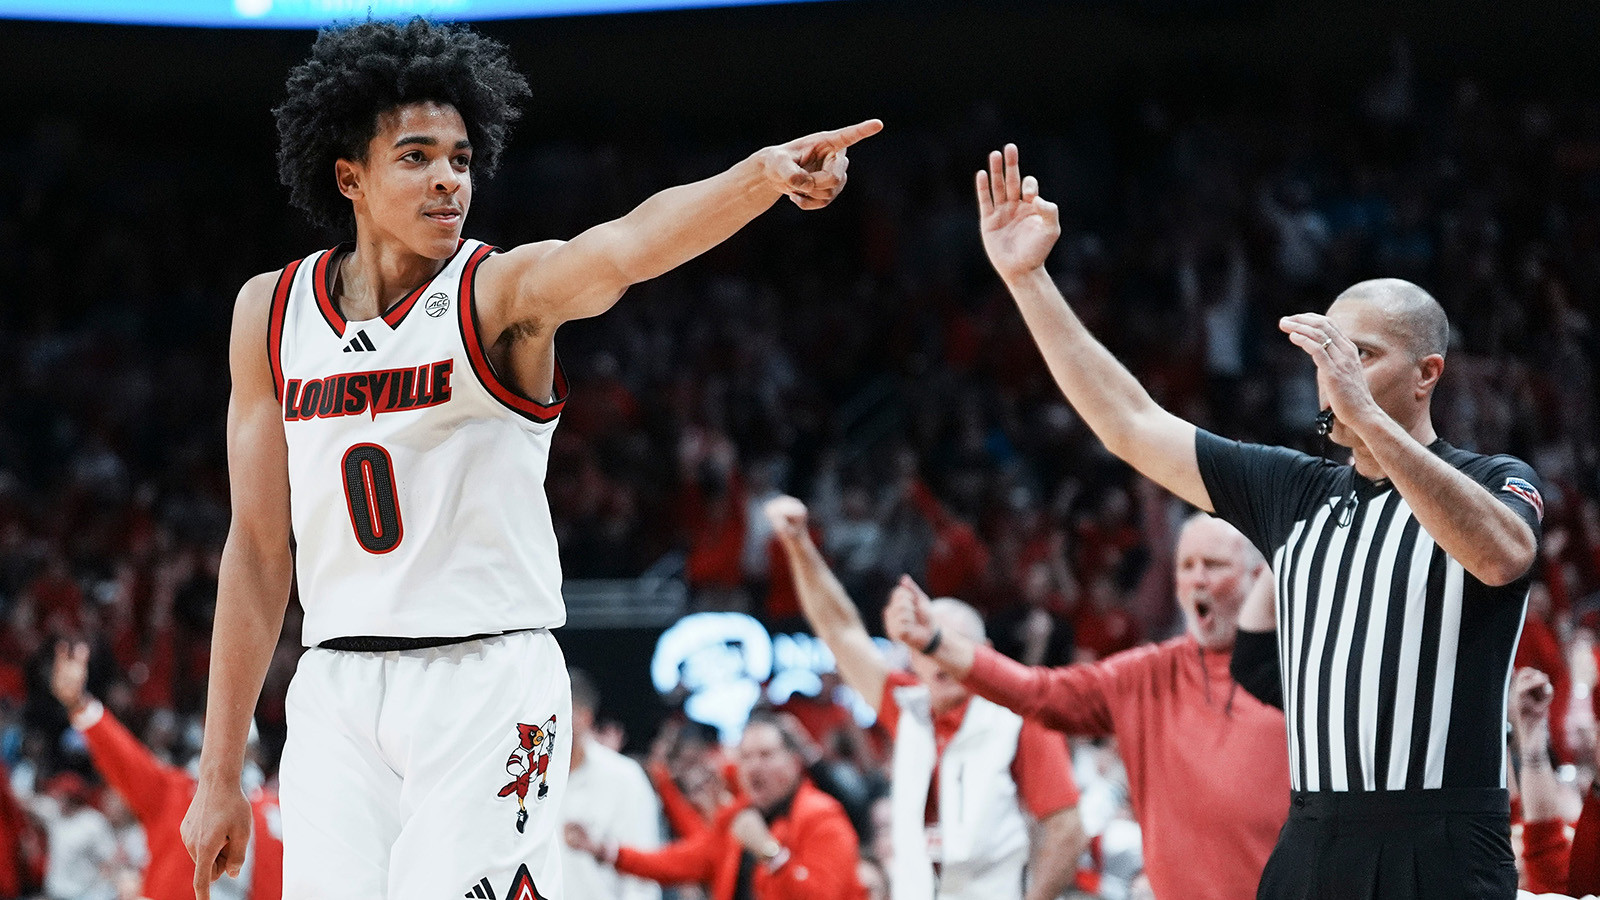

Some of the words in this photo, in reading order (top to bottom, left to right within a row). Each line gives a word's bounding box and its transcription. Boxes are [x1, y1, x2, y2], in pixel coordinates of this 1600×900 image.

[429, 298, 449, 308] ACC
[285, 358, 453, 422] LOUISVILLE
[341, 442, 403, 555] 0
